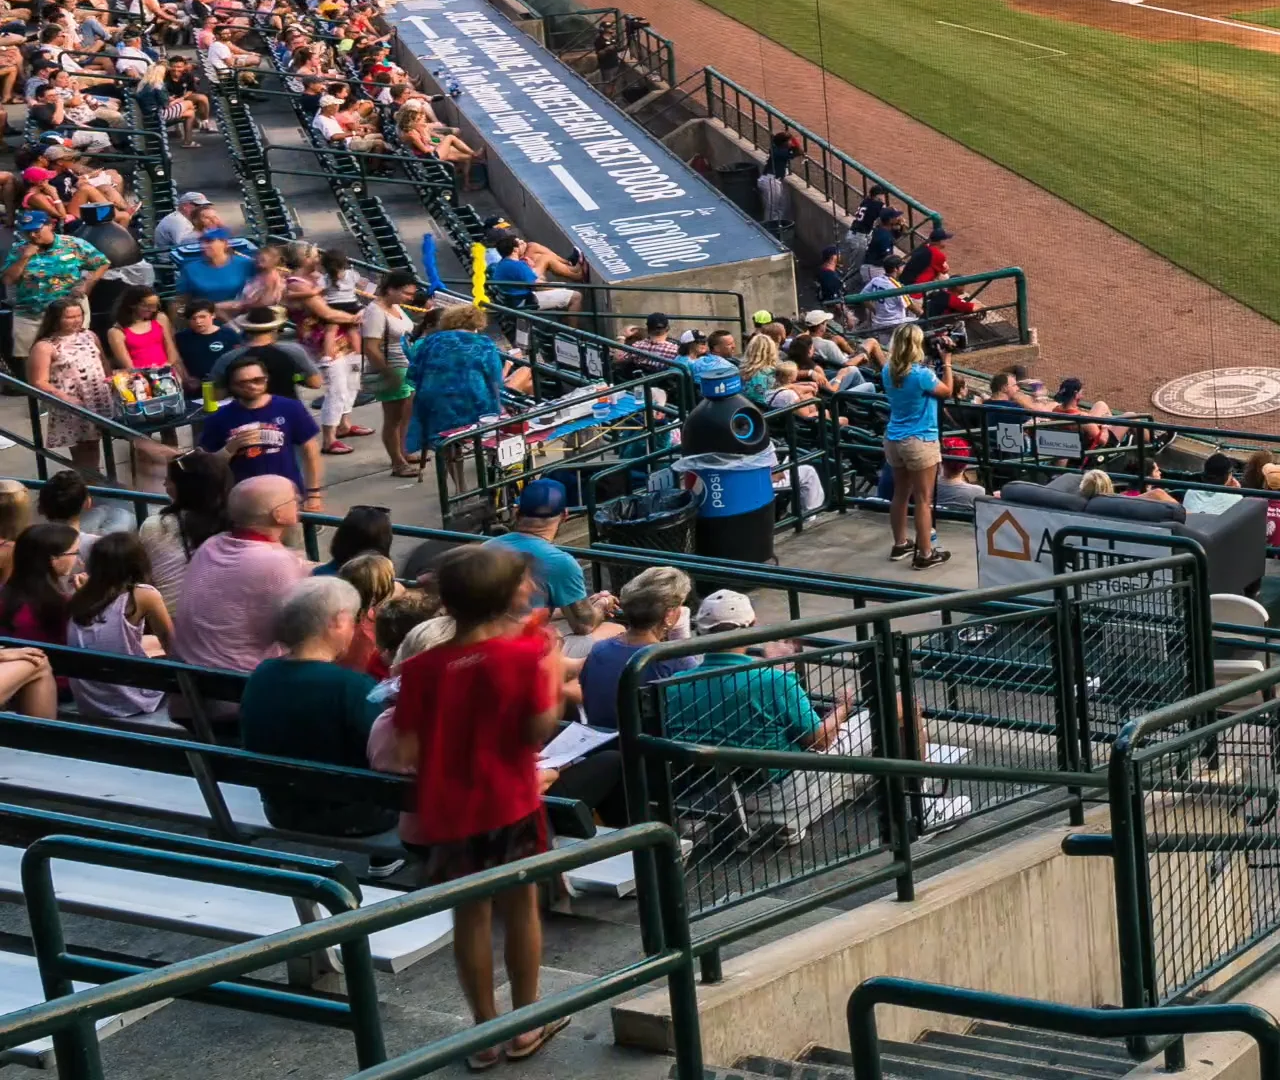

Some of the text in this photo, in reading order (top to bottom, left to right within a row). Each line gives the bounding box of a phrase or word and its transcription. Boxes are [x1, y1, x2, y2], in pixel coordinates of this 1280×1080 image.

[507, 69, 561, 87] THE
[488, 111, 538, 135] Living
[521, 84, 623, 140] SWEETHEART
[502, 132, 563, 163] Options
[579, 138, 653, 167] NEXT
[607, 165, 686, 203] DOOR
[571, 221, 632, 275] LiveCaroline.com
[609, 209, 721, 268] Caroline
[499, 441, 523, 462] 112
[710, 473, 726, 509] pepsi
